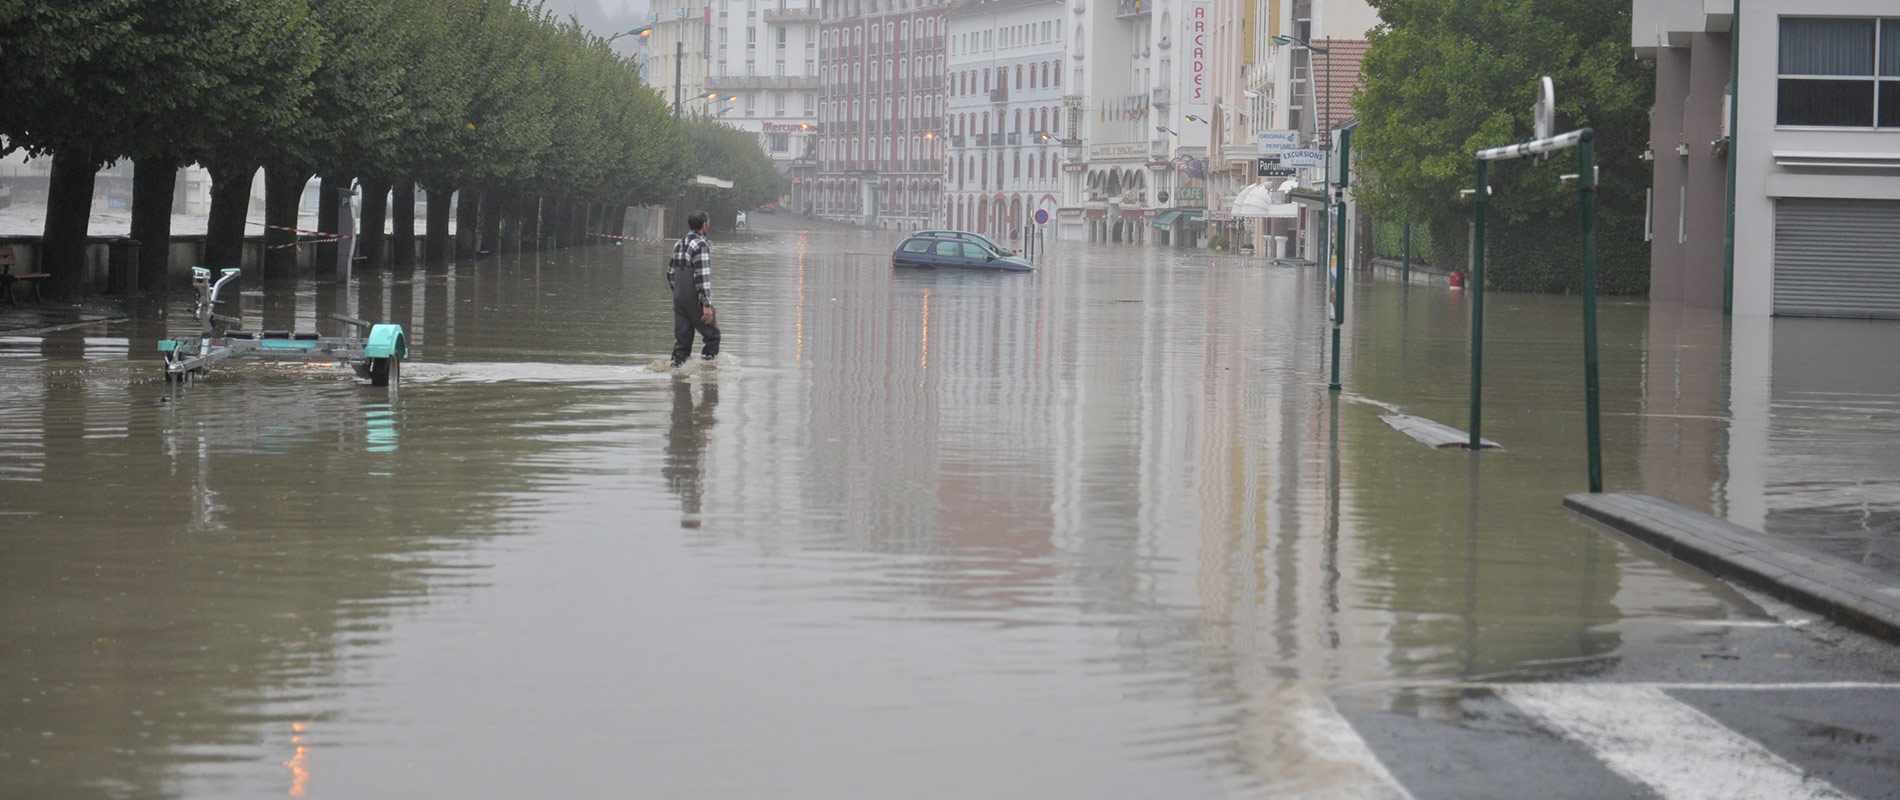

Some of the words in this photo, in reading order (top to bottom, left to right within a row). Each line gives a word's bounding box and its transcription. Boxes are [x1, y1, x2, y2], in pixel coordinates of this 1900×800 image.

[1194, 7, 1204, 99] ARCADES
[1283, 151, 1323, 160] EXCURSIONS
[1259, 160, 1294, 171] Parfum
[1181, 188, 1201, 199] CAFE
[342, 197, 349, 206] P
[1210, 212, 1230, 220] HOTEL
